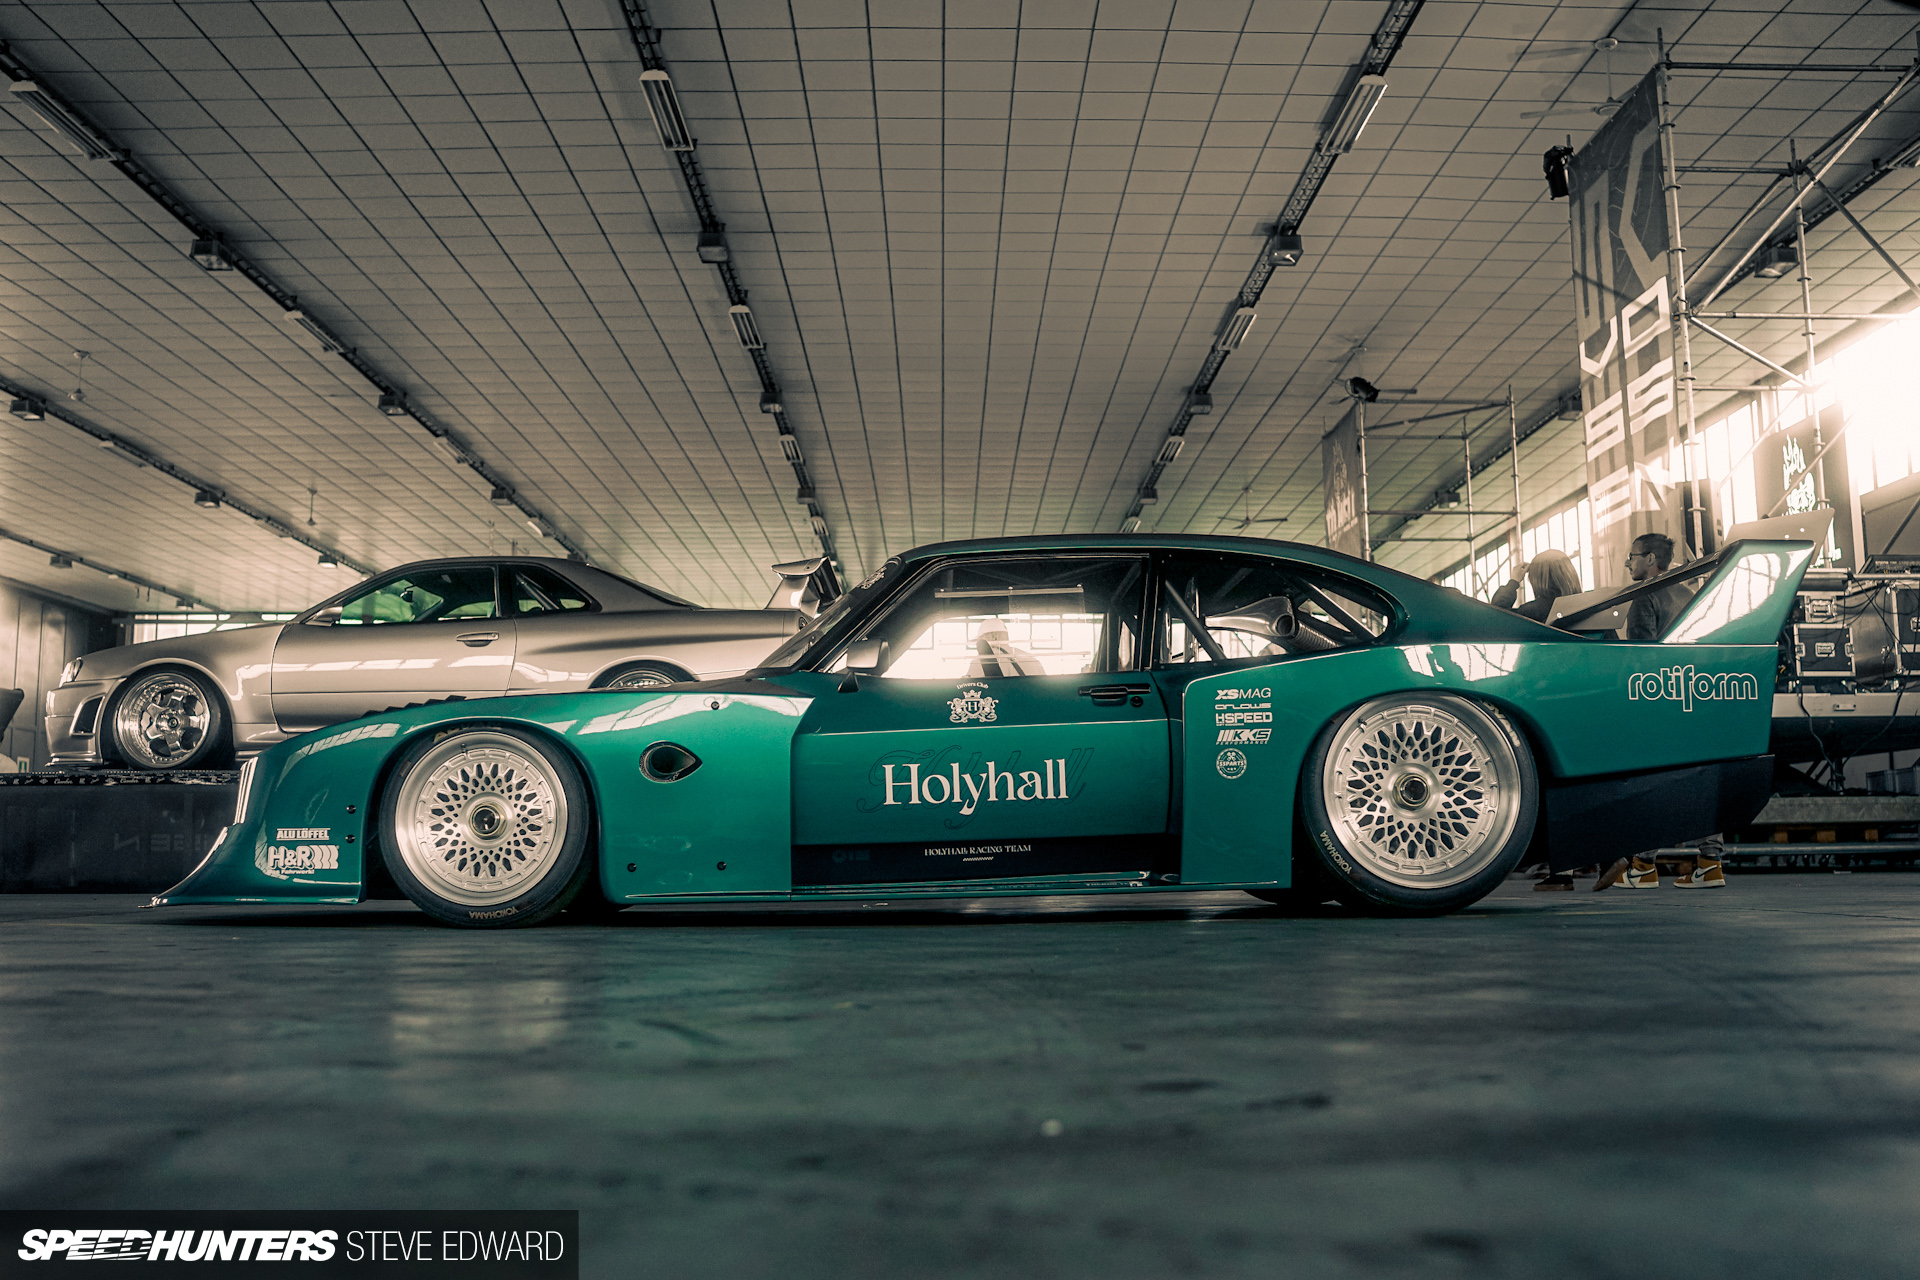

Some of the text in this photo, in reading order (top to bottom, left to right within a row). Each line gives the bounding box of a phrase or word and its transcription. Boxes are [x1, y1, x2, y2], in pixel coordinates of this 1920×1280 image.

[1628, 664, 1758, 712] rotiform
[881, 758, 1070, 816] Holyhall
[276, 830, 295, 839] ALU
[267, 845, 315, 870] H&R
[969, 845, 1003, 854] RACING
[1004, 844, 1031, 853] TEAM
[1320, 830, 1352, 874] YOKOHAMA
[469, 906, 519, 919] YOKOHAMA
